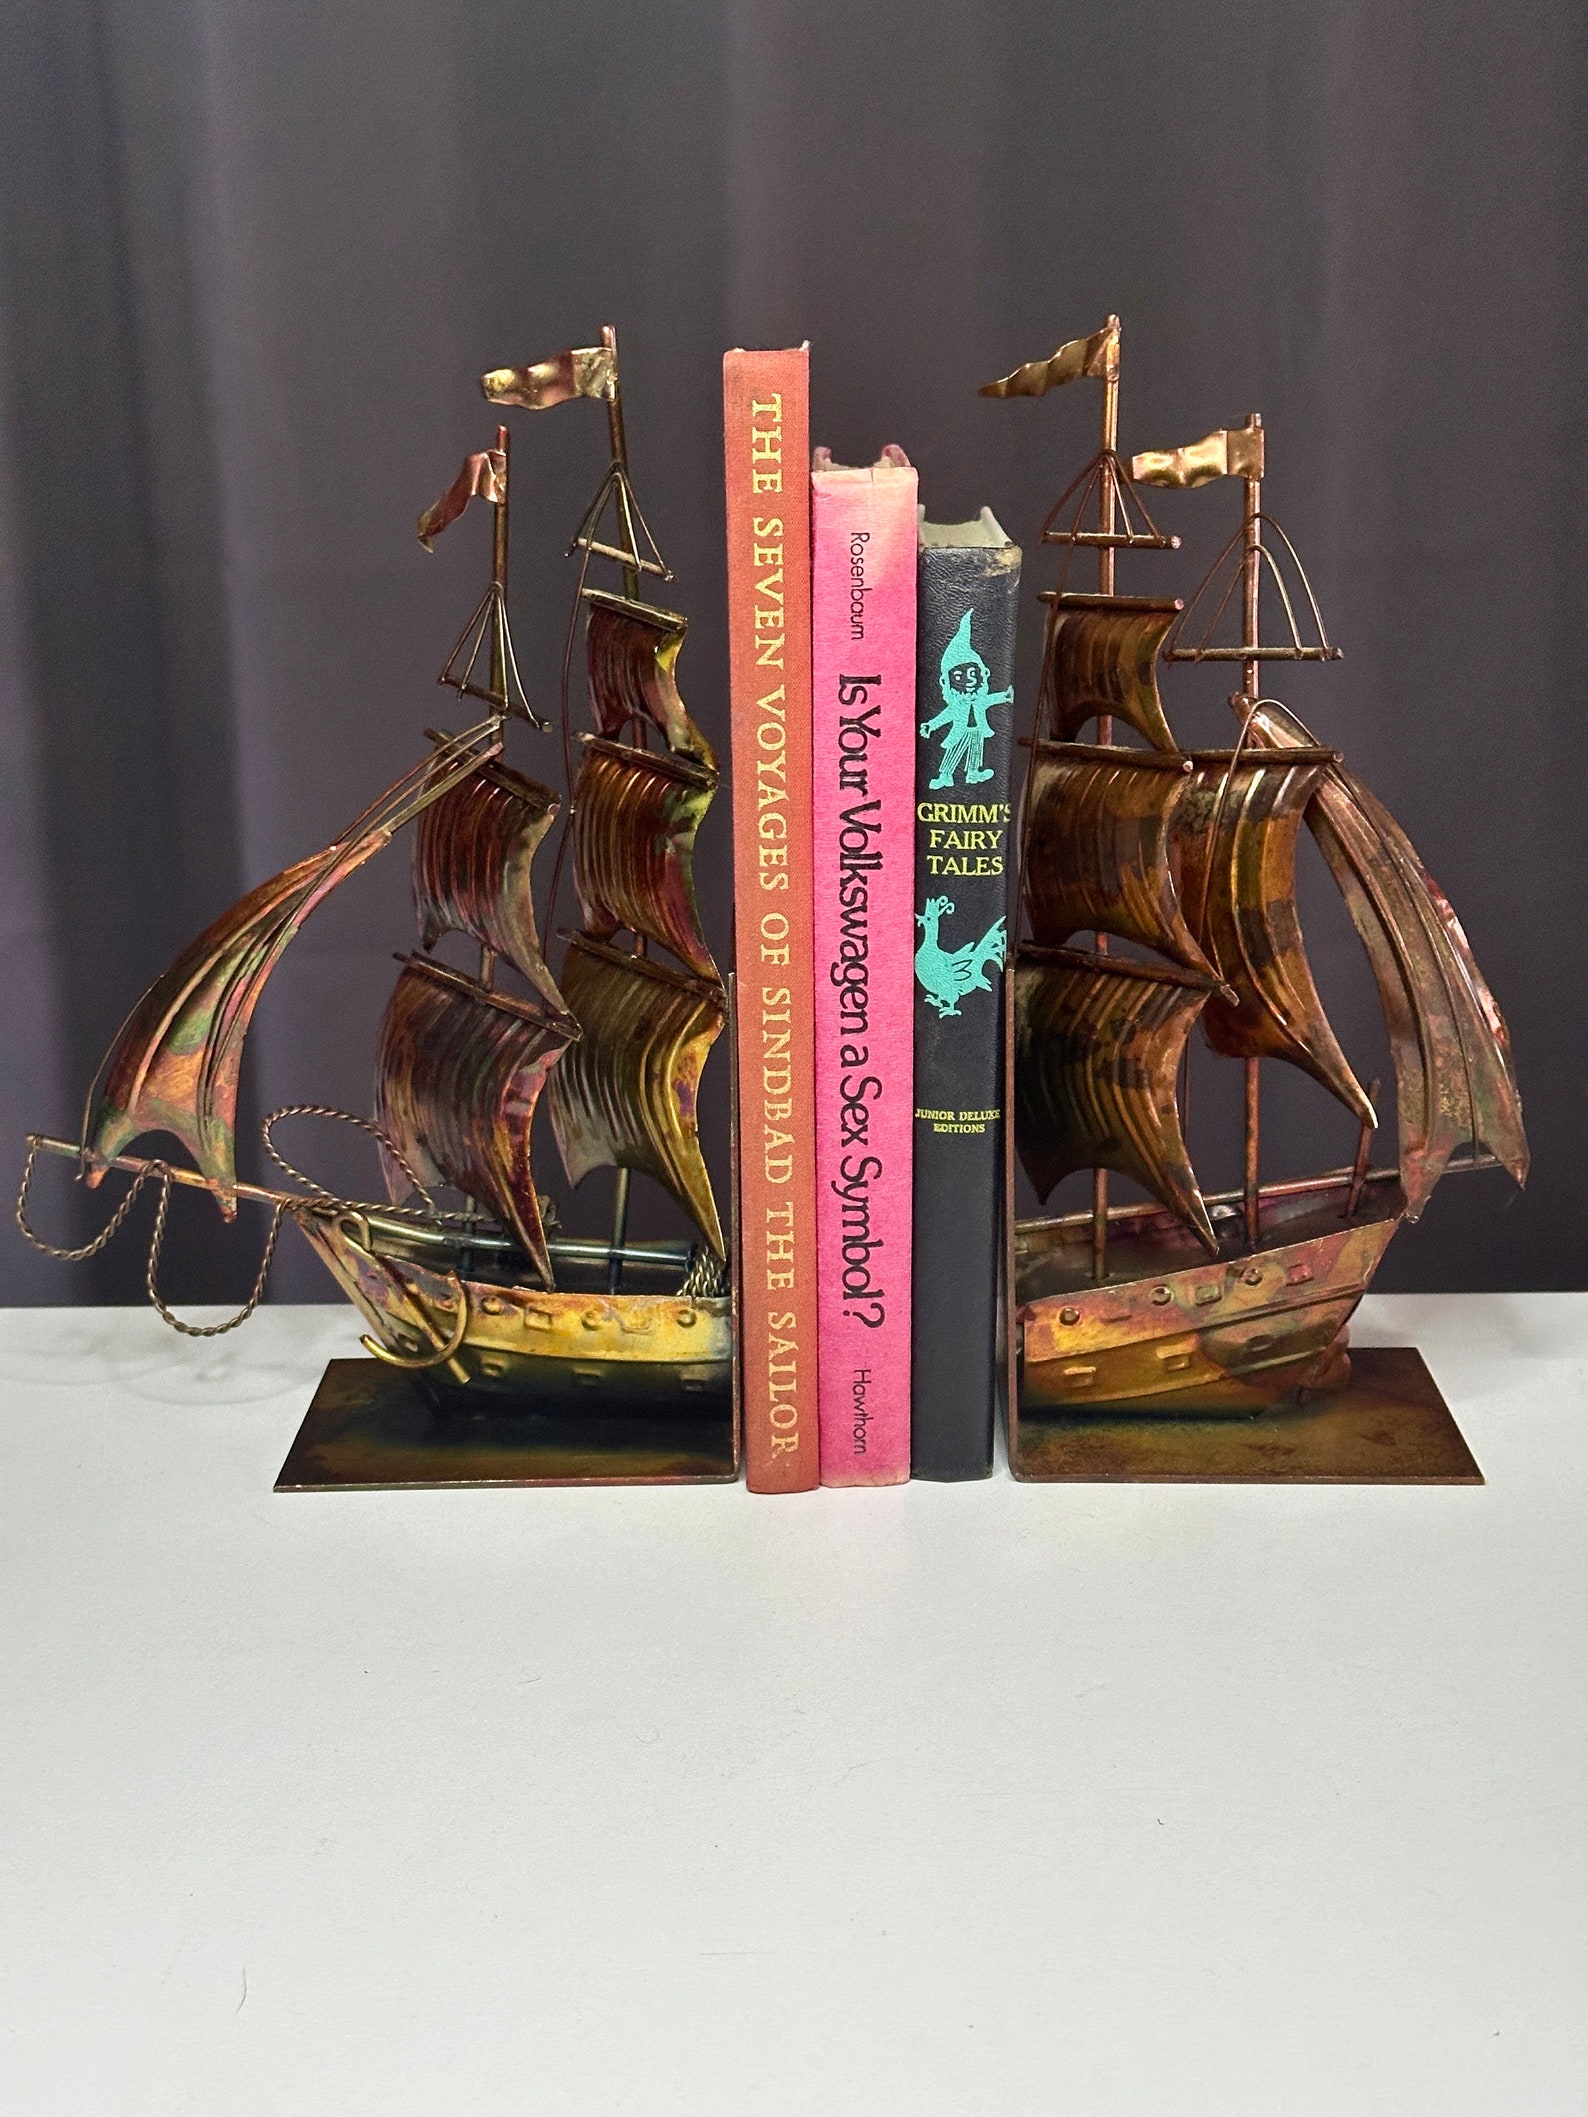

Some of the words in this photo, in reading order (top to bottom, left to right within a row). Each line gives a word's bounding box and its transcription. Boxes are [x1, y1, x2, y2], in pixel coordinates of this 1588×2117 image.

[751, 392, 783, 494] THE
[752, 516, 786, 670] SEVEN
[850, 532, 873, 640] Rosenbaum
[838, 673, 882, 705] Is
[755, 683, 790, 891] VOYAGES
[838, 705, 882, 797] Your
[917, 802, 1011, 824] GRIMM'S
[929, 829, 1004, 850] FAIRY
[926, 855, 1004, 876] TALES
[760, 912, 791, 967] OF
[830, 799, 884, 1036] Volkswagen
[761, 987, 795, 1184] SINDBAD
[839, 1044, 869, 1069] a
[839, 1074, 883, 1148] Sex
[915, 1108, 956, 1121] JUNIOR
[958, 1109, 1000, 1121] DELUXE
[933, 1123, 986, 1134] EDITIONS
[765, 1201, 795, 1291] THE
[830, 1155, 886, 1329] Symbol?
[768, 1311, 799, 1459] SAILOR
[852, 1369, 874, 1456] Hawthorn
